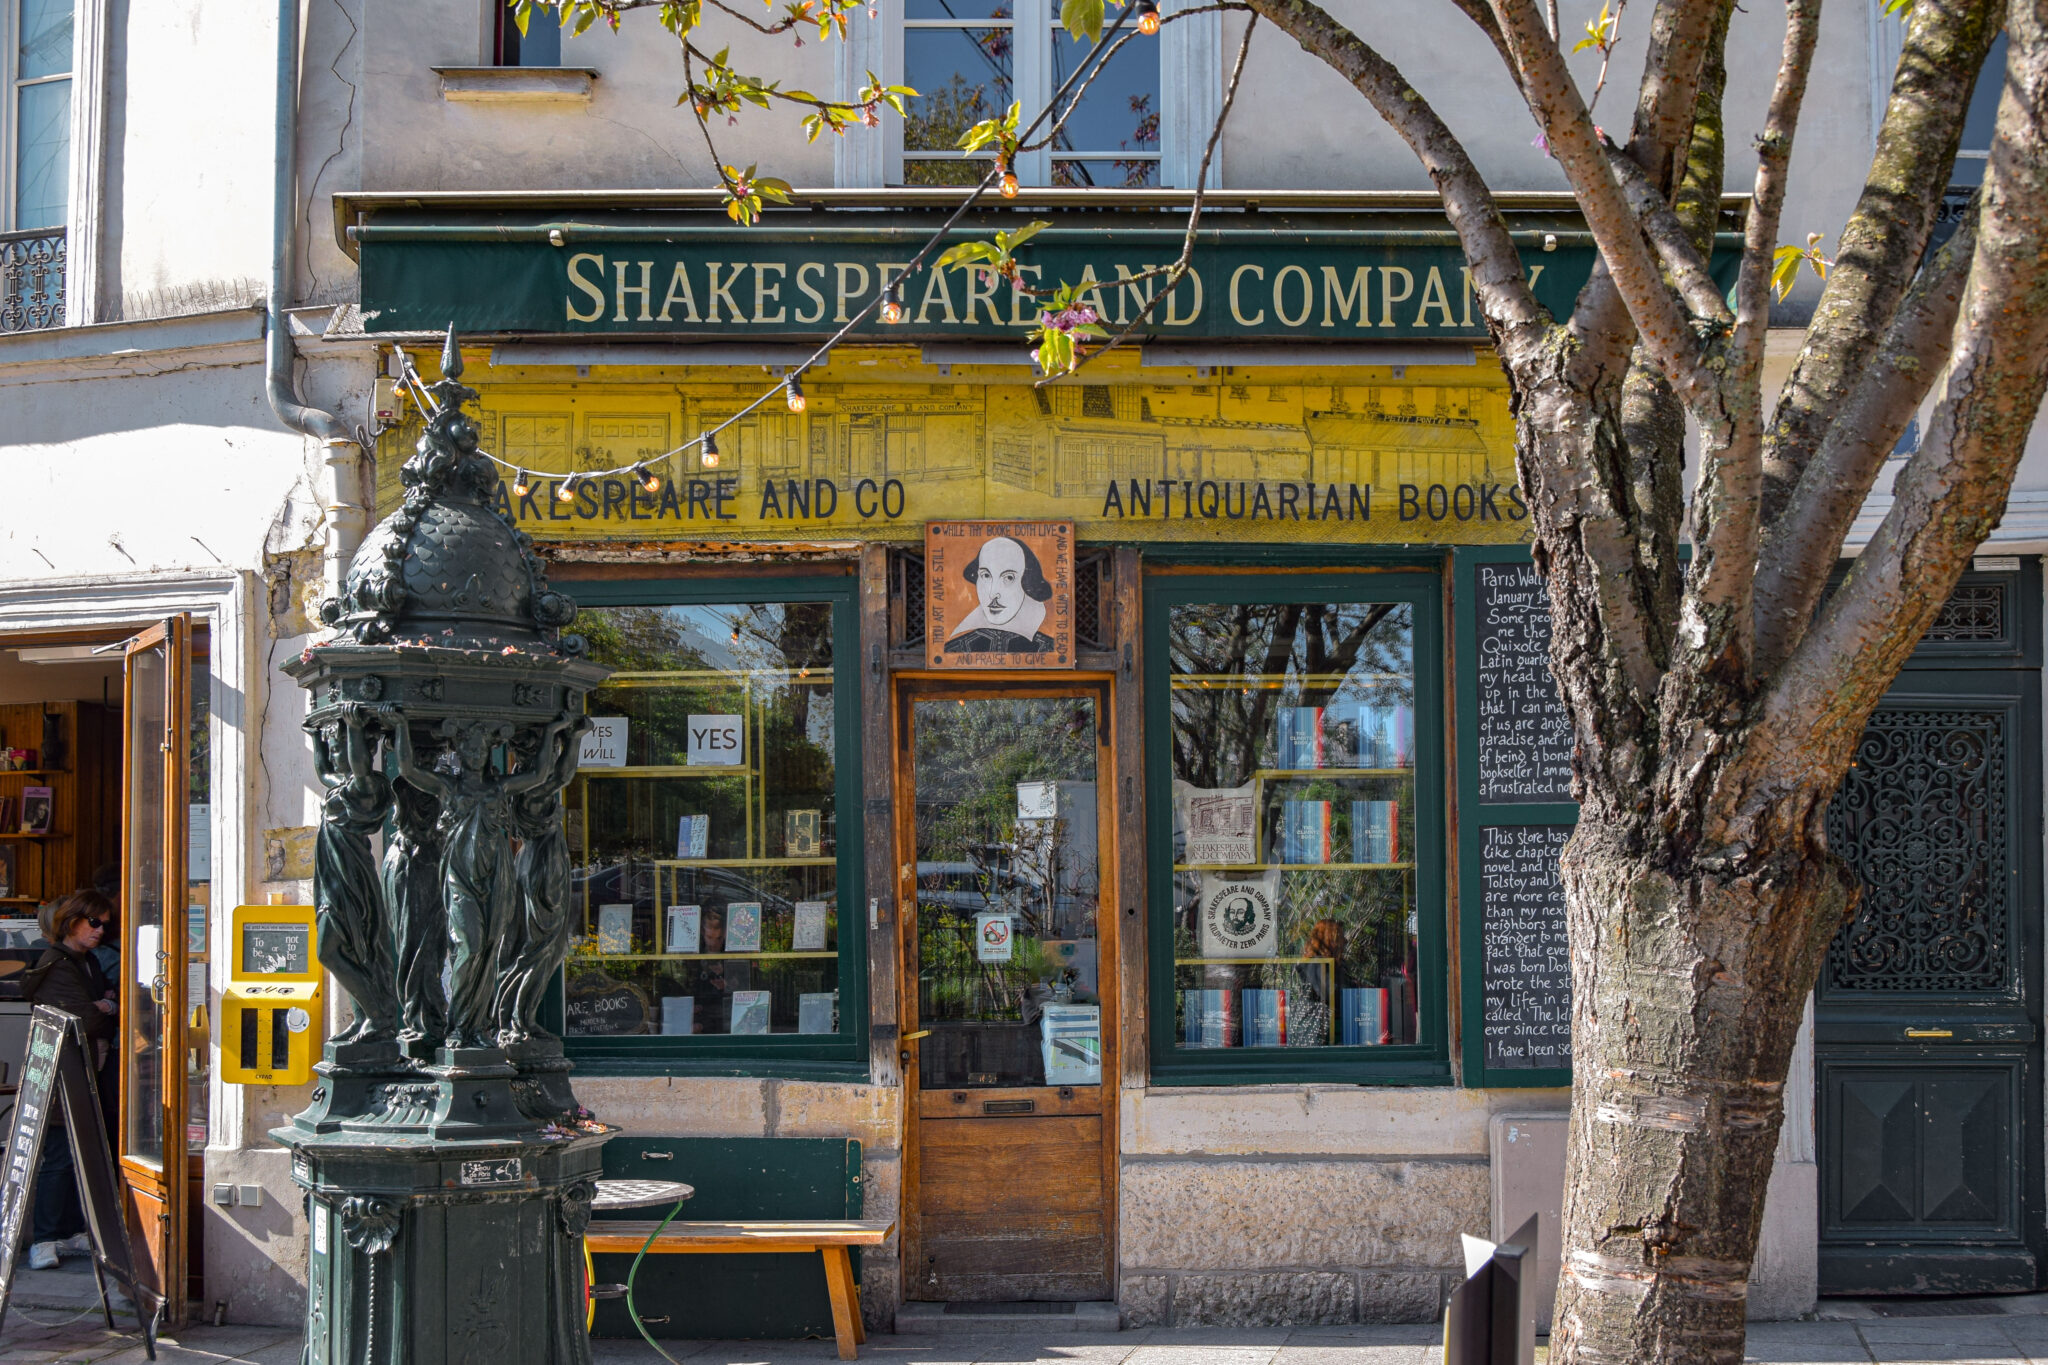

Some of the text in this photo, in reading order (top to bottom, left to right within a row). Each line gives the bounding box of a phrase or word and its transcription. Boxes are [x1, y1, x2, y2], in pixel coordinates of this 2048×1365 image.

[566, 253, 1545, 328] SHAKESPEARE AND COMPA
[494, 479, 905, 520] AKESPEARE AND CO
[1102, 479, 1528, 522] ANTIQUARIAN BOOKS
[943, 525, 965, 536] WHILE
[969, 525, 983, 536] THY
[986, 524, 1011, 536] BOOKE
[1014, 524, 1036, 536] DOTH
[1056, 535, 1068, 550] AND
[933, 547, 944, 572] STILL
[1056, 552, 1068, 565] WE
[1056, 566, 1068, 588] HAVE
[1482, 567, 1516, 587] Paris
[1517, 566, 1542, 587] Wall
[1486, 587, 1534, 611] January
[933, 606, 944, 622] ART
[1486, 608, 1551, 629] Some peo
[1056, 620, 1068, 630] TO
[1498, 624, 1549, 638] me the
[1056, 632, 1068, 655] READ
[1483, 636, 1543, 655] Quixote
[956, 653, 1046, 666] AND PRAISE TO GIVE
[1480, 654, 1514, 669] Latin
[1480, 667, 1552, 688] my head is
[1486, 689, 1501, 703] up
[1508, 686, 1520, 699] in
[1526, 684, 1548, 699] the
[1479, 700, 1506, 715] that
[1512, 700, 1516, 715] I
[1521, 704, 1540, 713] can
[591, 726, 613, 738] YES
[1481, 716, 1571, 737] of us are ange
[692, 728, 737, 750] YES
[1479, 729, 1537, 754] paradise,
[1538, 732, 1558, 746] and
[583, 748, 616, 759] WILL
[1480, 748, 1493, 767] of
[1495, 749, 1527, 768] being
[1532, 751, 1539, 761] a
[1480, 762, 1574, 779] bookseller I am mo
[1479, 783, 1486, 795] a
[1489, 778, 1554, 799] frustrated
[1483, 827, 1569, 845] This store has
[1191, 851, 1252, 860] AND COMPANY
[1193, 843, 1249, 852] SHAKESPEARE
[1483, 844, 1564, 862] like chapter
[1484, 859, 1561, 873] novel and th
[1483, 873, 1527, 893] Tolstoy
[1529, 871, 1550, 886] and
[1208, 885, 1272, 921] SHAKESPEARE AND COMPANY
[1485, 891, 1567, 902] are more rea
[1486, 905, 1514, 918] than
[1520, 907, 1537, 920] my
[1484, 917, 1568, 935] neighbors an
[253, 937, 264, 947] To
[285, 935, 299, 943] not
[1209, 922, 1270, 949] KILOMETER ZERO PARIS
[1484, 931, 1537, 949] stranger
[1540, 930, 1551, 943] to
[252, 947, 265, 958] be,
[286, 951, 297, 960] be
[287, 943, 296, 951] to
[1487, 944, 1512, 961] fact
[1518, 944, 1543, 957] that
[1486, 961, 1489, 975] I
[1493, 963, 1516, 973] was
[1520, 958, 1546, 973] born
[1485, 976, 1524, 990] wrote
[1530, 974, 1552, 988] the
[567, 997, 627, 1016] ARE BOOKS
[1486, 991, 1570, 1013] my life in a
[1485, 1007, 1522, 1021] called
[1484, 1025, 1511, 1036] ever
[1513, 1022, 1548, 1036] since
[1488, 1042, 1492, 1059] I
[1498, 1039, 1525, 1057] have
[1528, 1038, 1554, 1056] been
